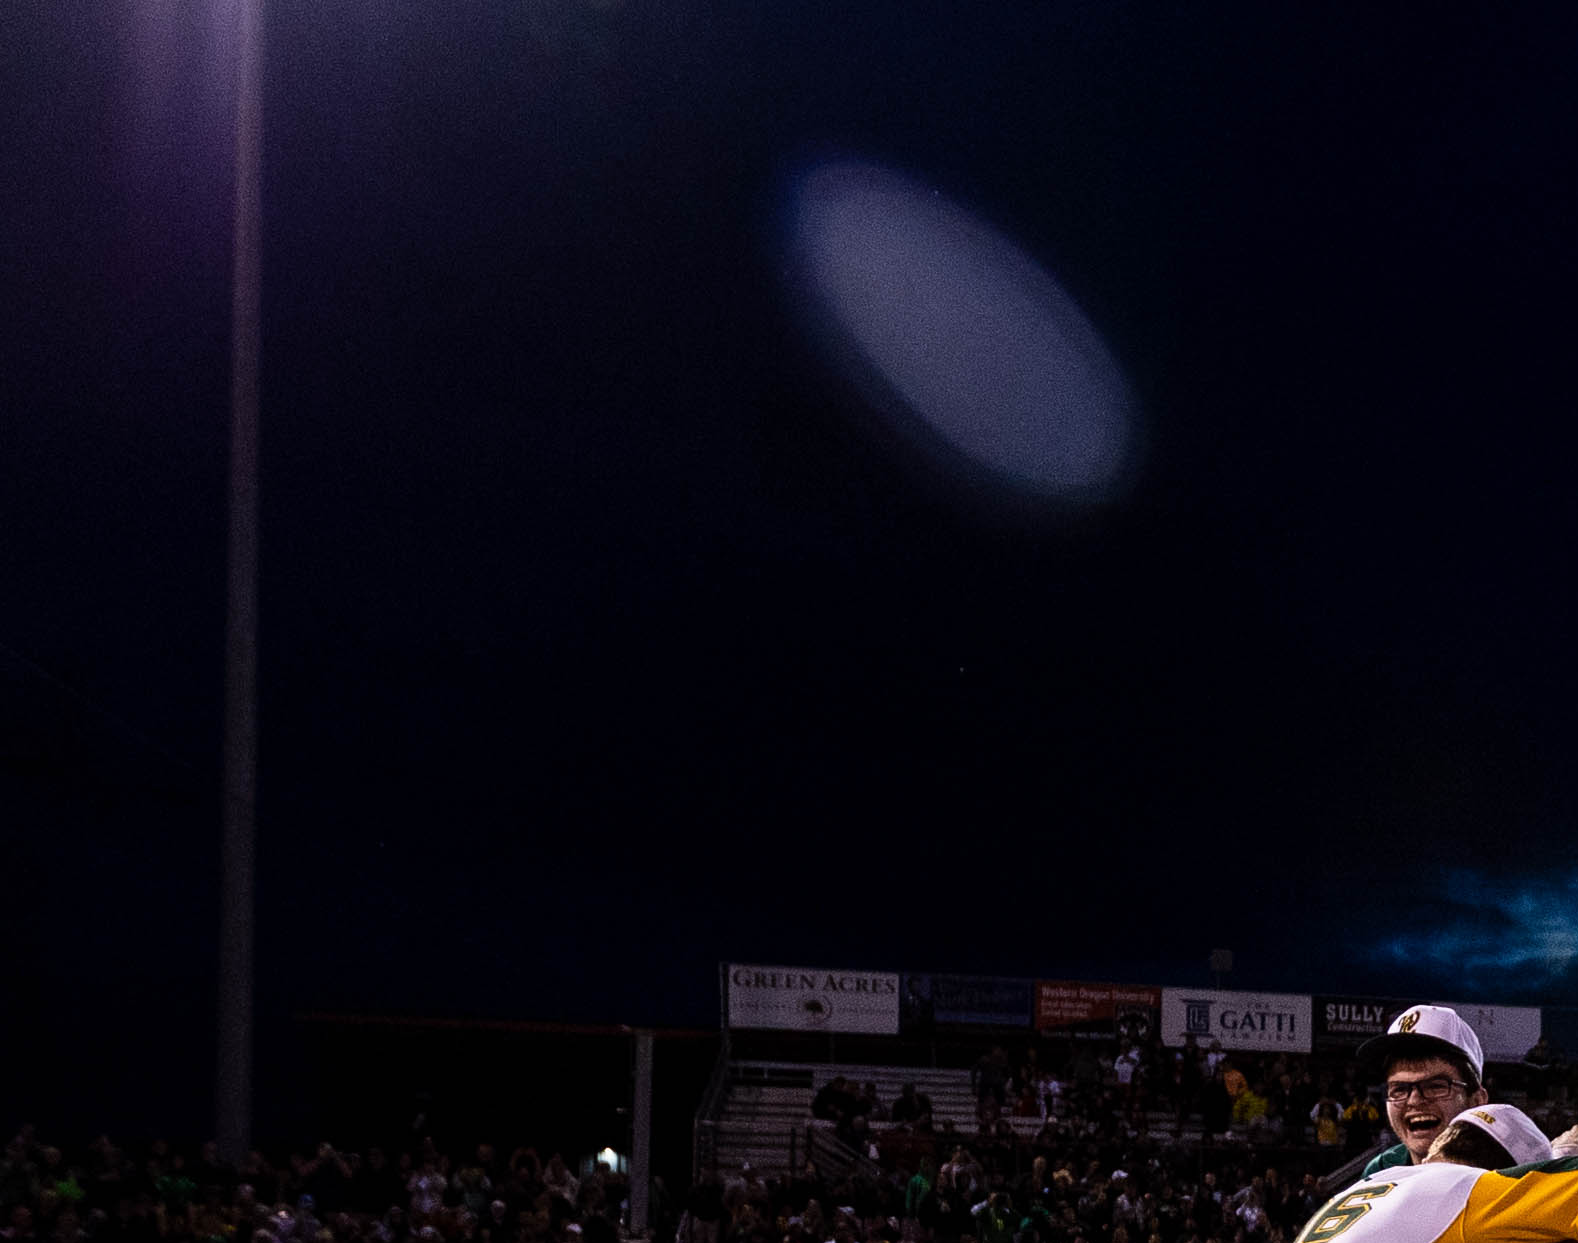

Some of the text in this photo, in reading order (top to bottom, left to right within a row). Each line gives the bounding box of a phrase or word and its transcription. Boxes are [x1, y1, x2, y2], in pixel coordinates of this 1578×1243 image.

[733, 968, 897, 995] GREEN ACRES
[1220, 1010, 1296, 1032] GATTI
[1325, 1003, 1384, 1023] SULLY
